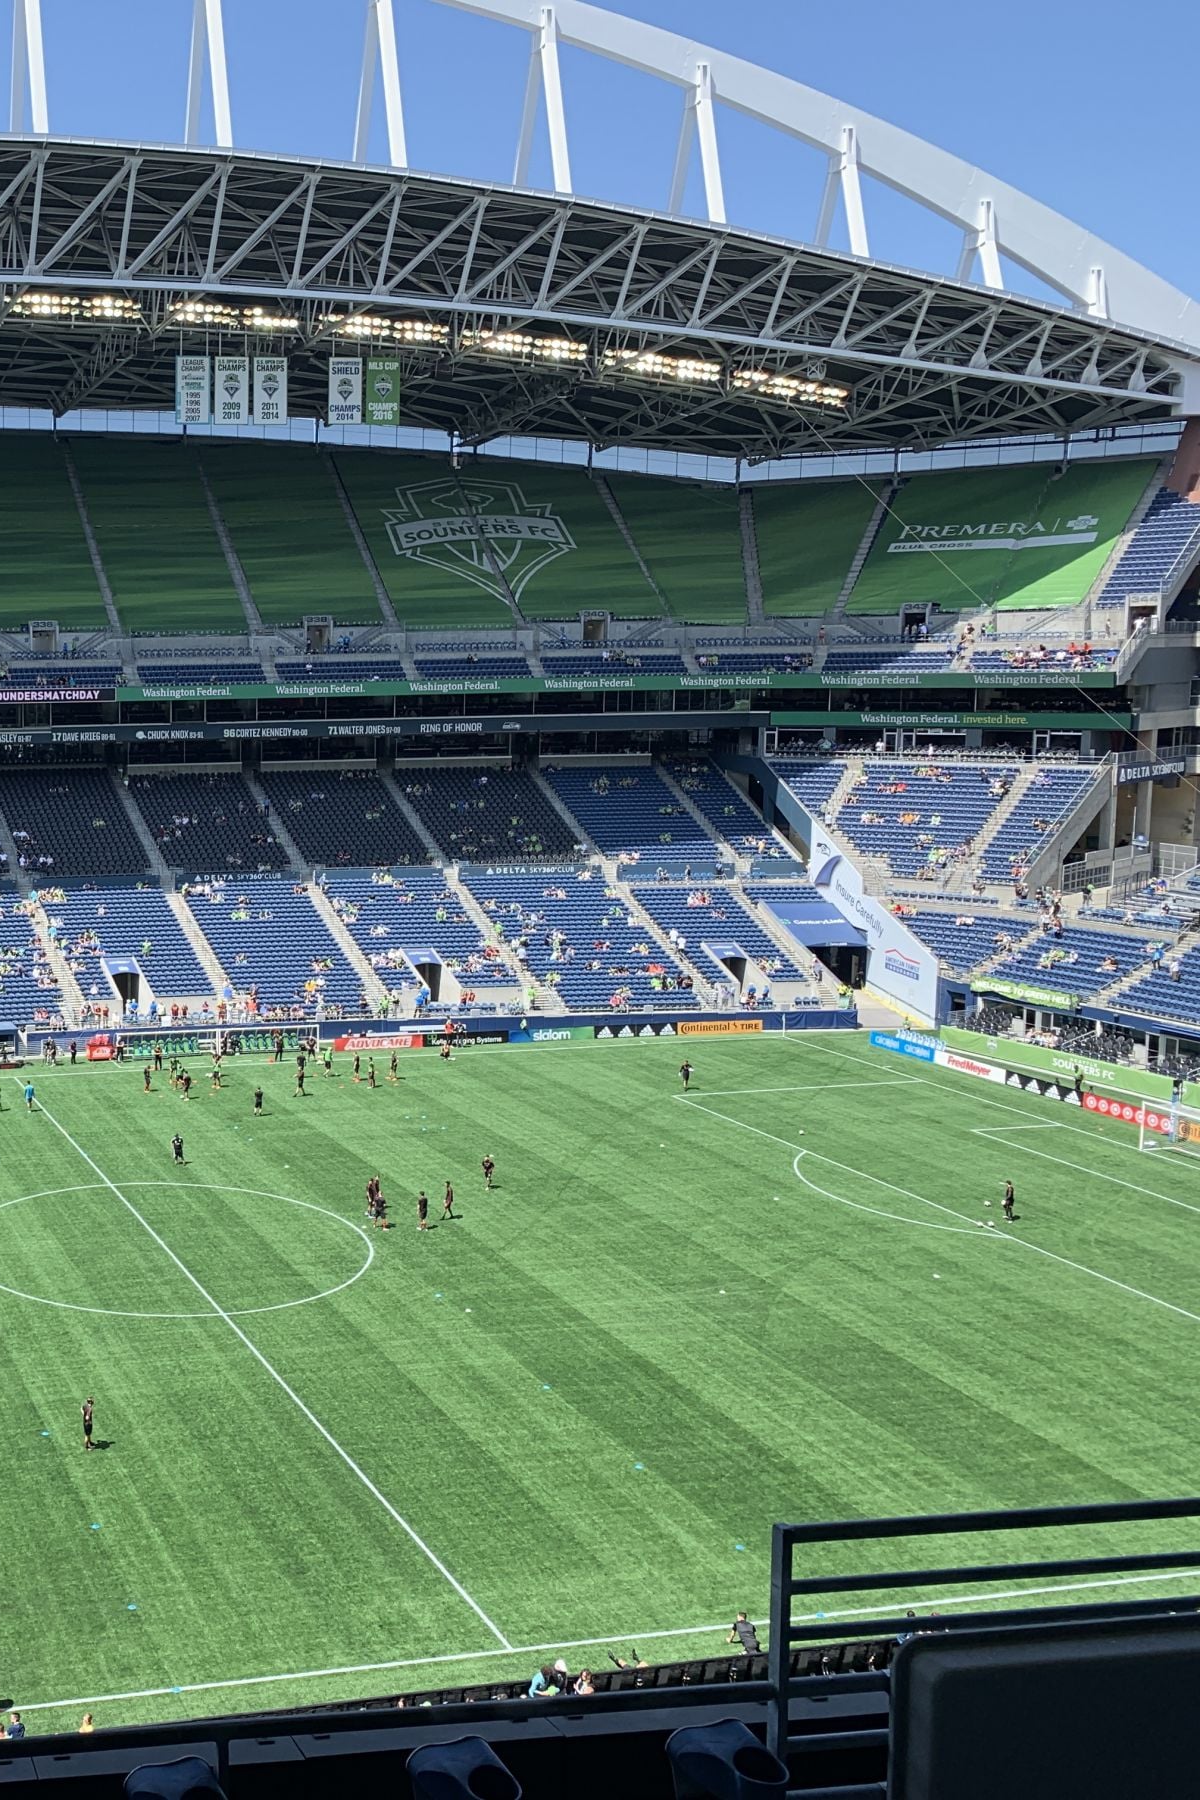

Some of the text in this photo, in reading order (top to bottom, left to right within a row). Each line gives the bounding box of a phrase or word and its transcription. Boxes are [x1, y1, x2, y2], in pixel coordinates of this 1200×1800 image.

[332, 367, 360, 375] SHIELD
[368, 362, 399, 370] MLS CUP
[223, 402, 240, 410] 2009
[368, 403, 398, 411] CHAMPS
[223, 412, 240, 420] 2010
[262, 412, 279, 420] 2014
[373, 411, 392, 420] 2016
[528, 526, 561, 538] FC
[899, 521, 1046, 539] PREMERA
[545, 678, 636, 690] Washington Federal.
[680, 676, 773, 687] Washington Federal.
[821, 675, 922, 686] Washington Federal.
[974, 674, 1083, 685] Washington Federal.
[276, 684, 365, 695] Washington Federal.
[409, 680, 500, 692] Washington Federal.
[143, 687, 232, 698] Washington Federal.
[861, 714, 1028, 725] Washington Federal. invested here.
[224, 728, 292, 737] 96 CORTEZ KENNEDY
[328, 725, 385, 734] 71 WALTER JONES
[420, 723, 482, 733] RING OF HONOR
[52, 732, 100, 741] 17 DAVE KRIEG
[148, 730, 188, 739] CHUCK KNOX
[1127, 766, 1150, 779] DELTA
[835, 879, 885, 938] Insure Carefully
[975, 980, 1071, 1005] WELCOME TO GREEN HELL
[680, 1023, 759, 1032] Continental TIRE
[477, 1036, 502, 1044] Systems
[533, 1029, 571, 1041] slalom
[346, 1036, 411, 1049] ADVOCARE
[1052, 1058, 1115, 1080] SOUERS FC
